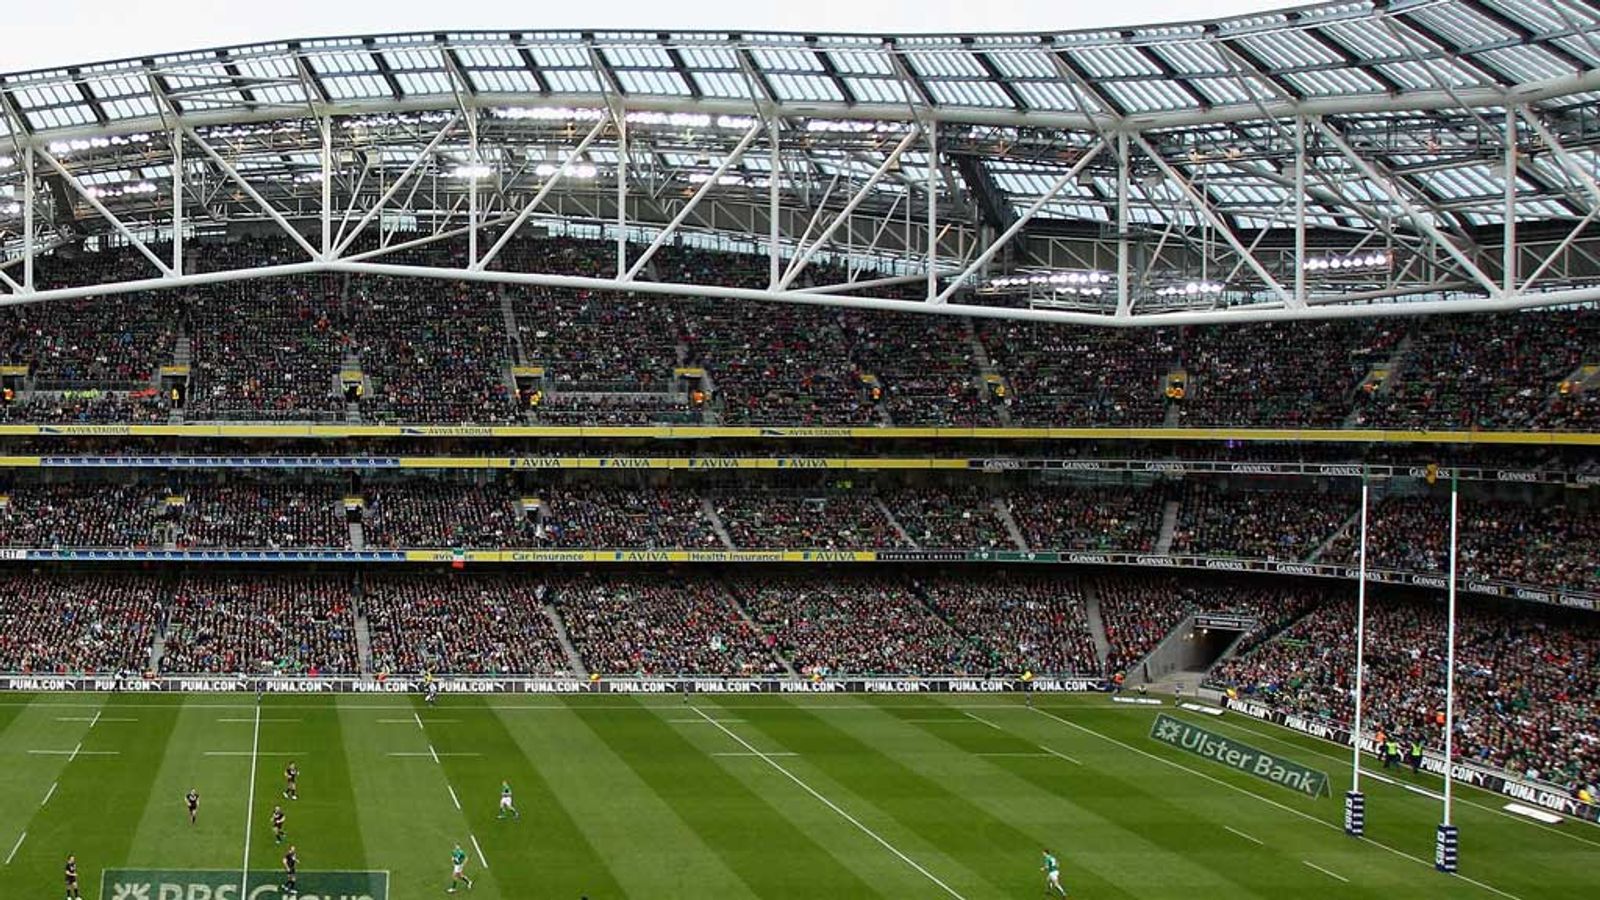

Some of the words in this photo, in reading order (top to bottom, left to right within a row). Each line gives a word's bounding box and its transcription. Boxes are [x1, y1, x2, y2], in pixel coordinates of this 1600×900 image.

[522, 459, 560, 467] AVIVA
[612, 459, 650, 467] AVIVA
[701, 459, 739, 467] AVIVA
[790, 459, 828, 467] AVIVA
[512, 552, 529, 560] Car
[533, 552, 584, 560] Insurance
[629, 552, 669, 560] AVIVA
[692, 552, 726, 560] Health
[728, 552, 780, 560] Insurance
[816, 552, 856, 560] AVIVA
[1069, 555, 1105, 564] GUINNESS
[1136, 555, 1173, 566] GUINNESS
[1206, 559, 1243, 570] GUINNESS
[1276, 563, 1314, 575] GUINNESS
[10, 680, 65, 690] PUMA.COM
[181, 681, 236, 691] PUMA.COM
[267, 681, 322, 691] PUMA.COM
[352, 682, 408, 692] PUMA.COM
[524, 682, 579, 692] PUMA.COM
[610, 682, 666, 692] PUMA.COM
[695, 682, 750, 692] PUMA.COM
[780, 682, 836, 692] PUMA.COM
[948, 681, 1003, 691] PUMA.COM
[1032, 681, 1087, 691] PUMA.COM
[1180, 728, 1252, 769] Ulster
[1253, 755, 1317, 793] Bank
[1502, 780, 1566, 811] PUMA.COM
